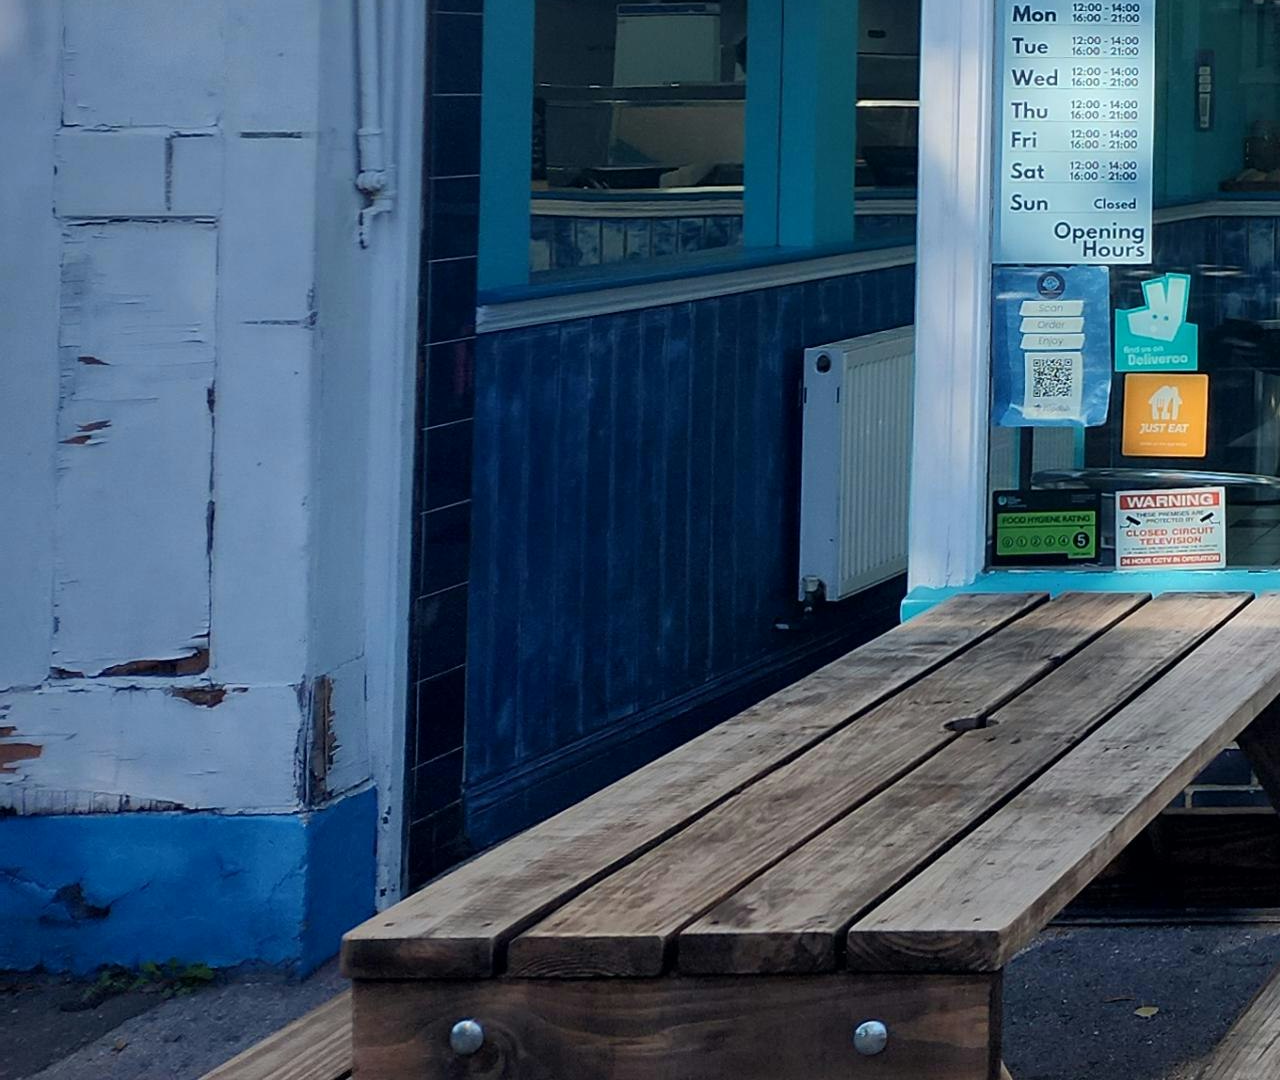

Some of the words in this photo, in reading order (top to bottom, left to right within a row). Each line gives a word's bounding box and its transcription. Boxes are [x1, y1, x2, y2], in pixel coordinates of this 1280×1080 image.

[1073, 3, 1102, 13] 12:00
[1112, 4, 1140, 12] 14:00
[1013, 6, 1056, 21] Mon
[1073, 14, 1101, 22] 16:00
[1111, 14, 1139, 22] 21:00
[1073, 36, 1101, 44] 12:00
[1111, 37, 1139, 45] 14:00
[1012, 38, 1048, 55] Tue
[1072, 47, 1100, 55] 16:00
[1111, 47, 1139, 55] 21:00
[1072, 67, 1101, 75] 12:00
[1111, 68, 1139, 76] 14:00
[1012, 70, 1057, 85] Wed
[1072, 78, 1100, 86] 16:00
[1110, 78, 1138, 86] 21:00
[1072, 100, 1100, 108] 12:00
[1011, 102, 1047, 118] Thu
[1071, 111, 1099, 119] 16:00
[1109, 111, 1137, 119] 21:00
[1071, 130, 1100, 138] 12:00
[1110, 130, 1137, 138] 14:00
[1012, 132, 1036, 147] Fri
[1071, 139, 1099, 149] 16:00
[1109, 139, 1137, 149] 21:00
[1011, 163, 1044, 179] Sat
[1071, 161, 1099, 171] 12:00
[1109, 161, 1137, 170] 14:00
[1071, 170, 1098, 180] 16:00
[1109, 170, 1137, 180] 21:00
[1011, 195, 1047, 210] Sun
[1094, 198, 1136, 209] Closed
[1054, 222, 1145, 243] Opening
[1083, 240, 1144, 257] Hours
[1038, 303, 1064, 312] Scan
[1037, 320, 1065, 329] Order
[1038, 336, 1065, 346] Enjoy
[1126, 352, 1188, 365] Deliveroo
[1140, 423, 1167, 433] JUST
[1168, 424, 1189, 432] EAT
[1127, 494, 1213, 508] WARNING
[1002, 516, 1027, 524] FOOD
[1028, 515, 1061, 523] HYGIENE
[1063, 514, 1091, 522] RATING
[1126, 528, 1168, 537] CLOSED
[1172, 527, 1214, 535] CIRCUIT
[1077, 535, 1085, 546] 5
[1140, 536, 1202, 545] TELEVISION
